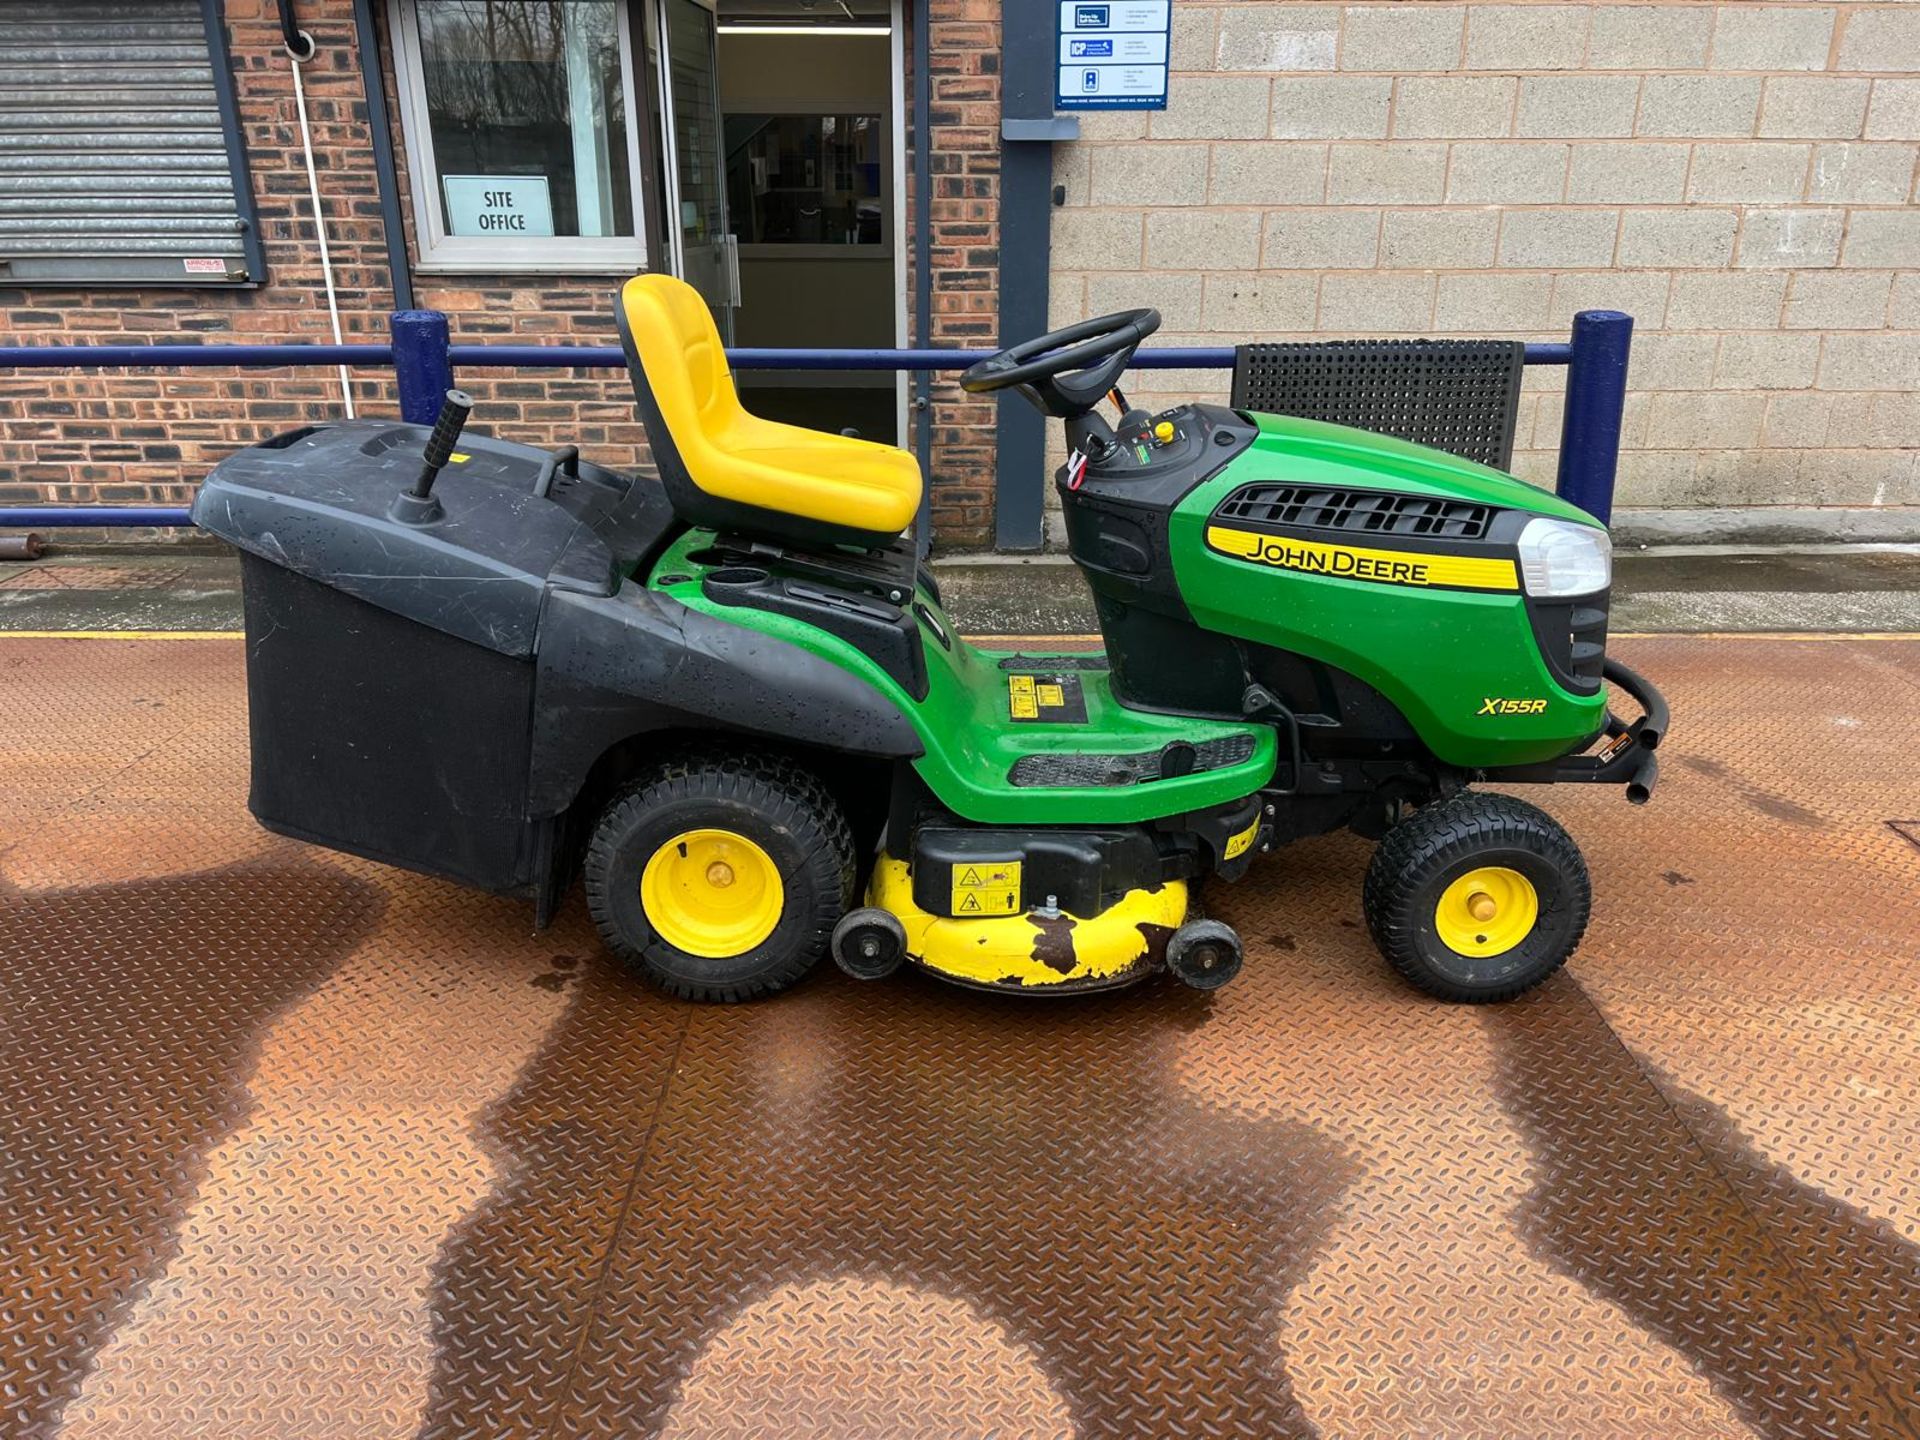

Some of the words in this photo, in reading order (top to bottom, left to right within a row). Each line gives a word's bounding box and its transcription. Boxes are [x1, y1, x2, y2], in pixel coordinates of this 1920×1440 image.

[1071, 42, 1086, 55] ICP
[484, 191, 513, 207] SITE
[479, 214, 526, 230] OFFICE
[1246, 537, 1327, 569] JOHN
[1332, 553, 1429, 581] DEERE
[1476, 698, 1547, 714] X155R
